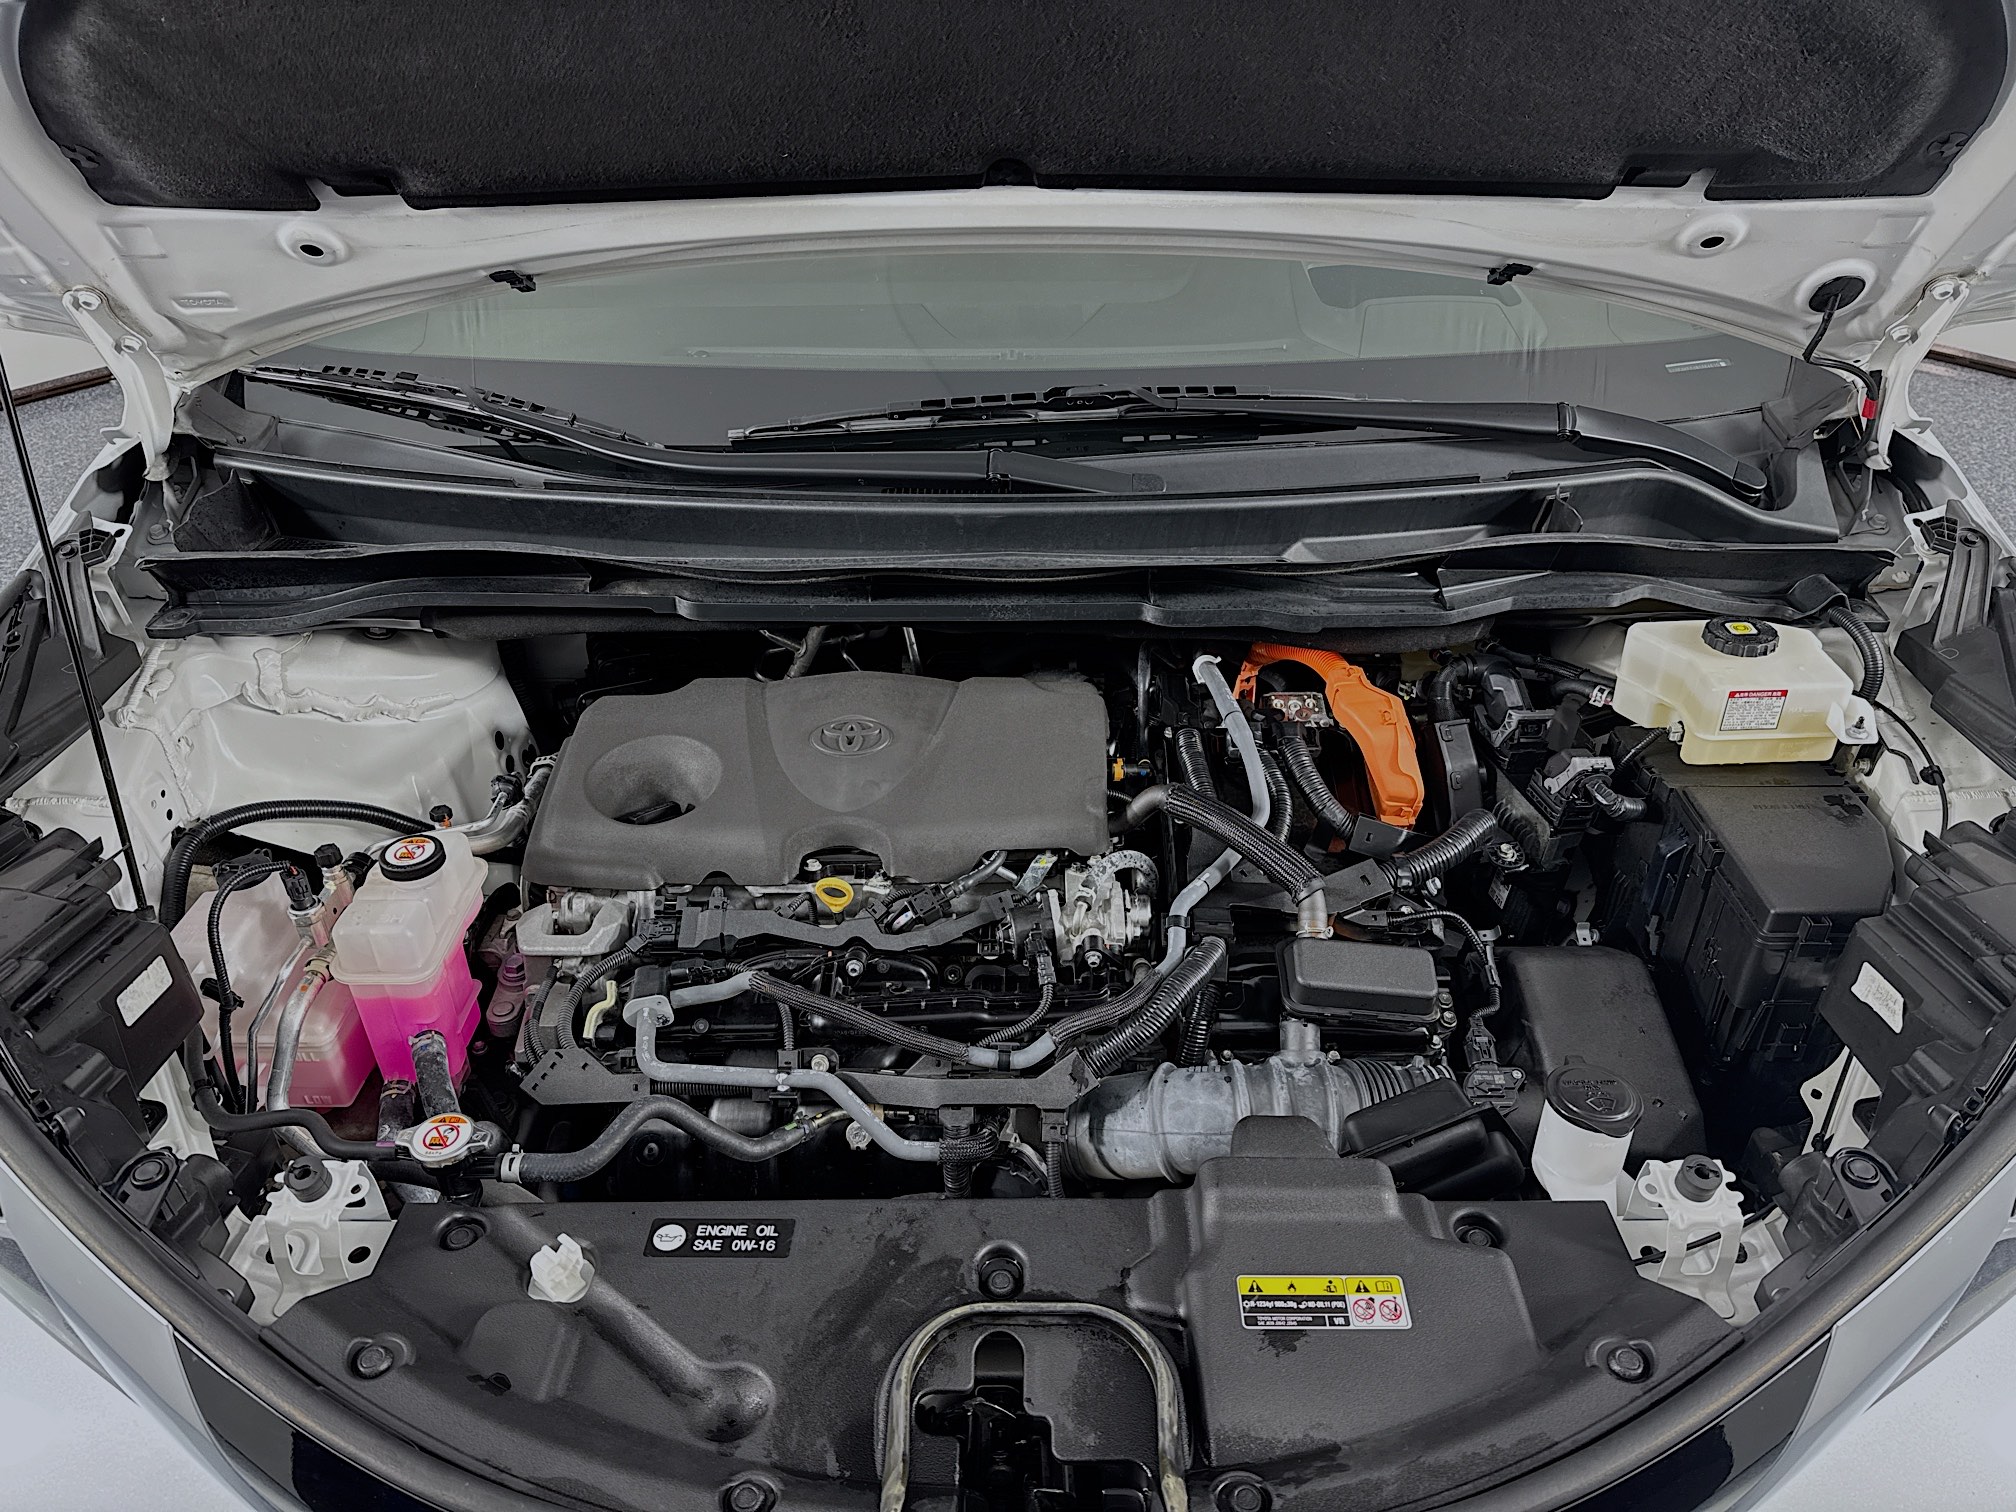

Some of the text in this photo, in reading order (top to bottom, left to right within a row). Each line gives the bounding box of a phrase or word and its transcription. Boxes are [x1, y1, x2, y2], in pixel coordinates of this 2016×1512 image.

[303, 1095, 332, 1105] LOW
[696, 1225, 779, 1237] ENGINE OIL
[692, 1239, 776, 1251] SAE 0W-16
[1333, 1317, 1346, 1325] VR
